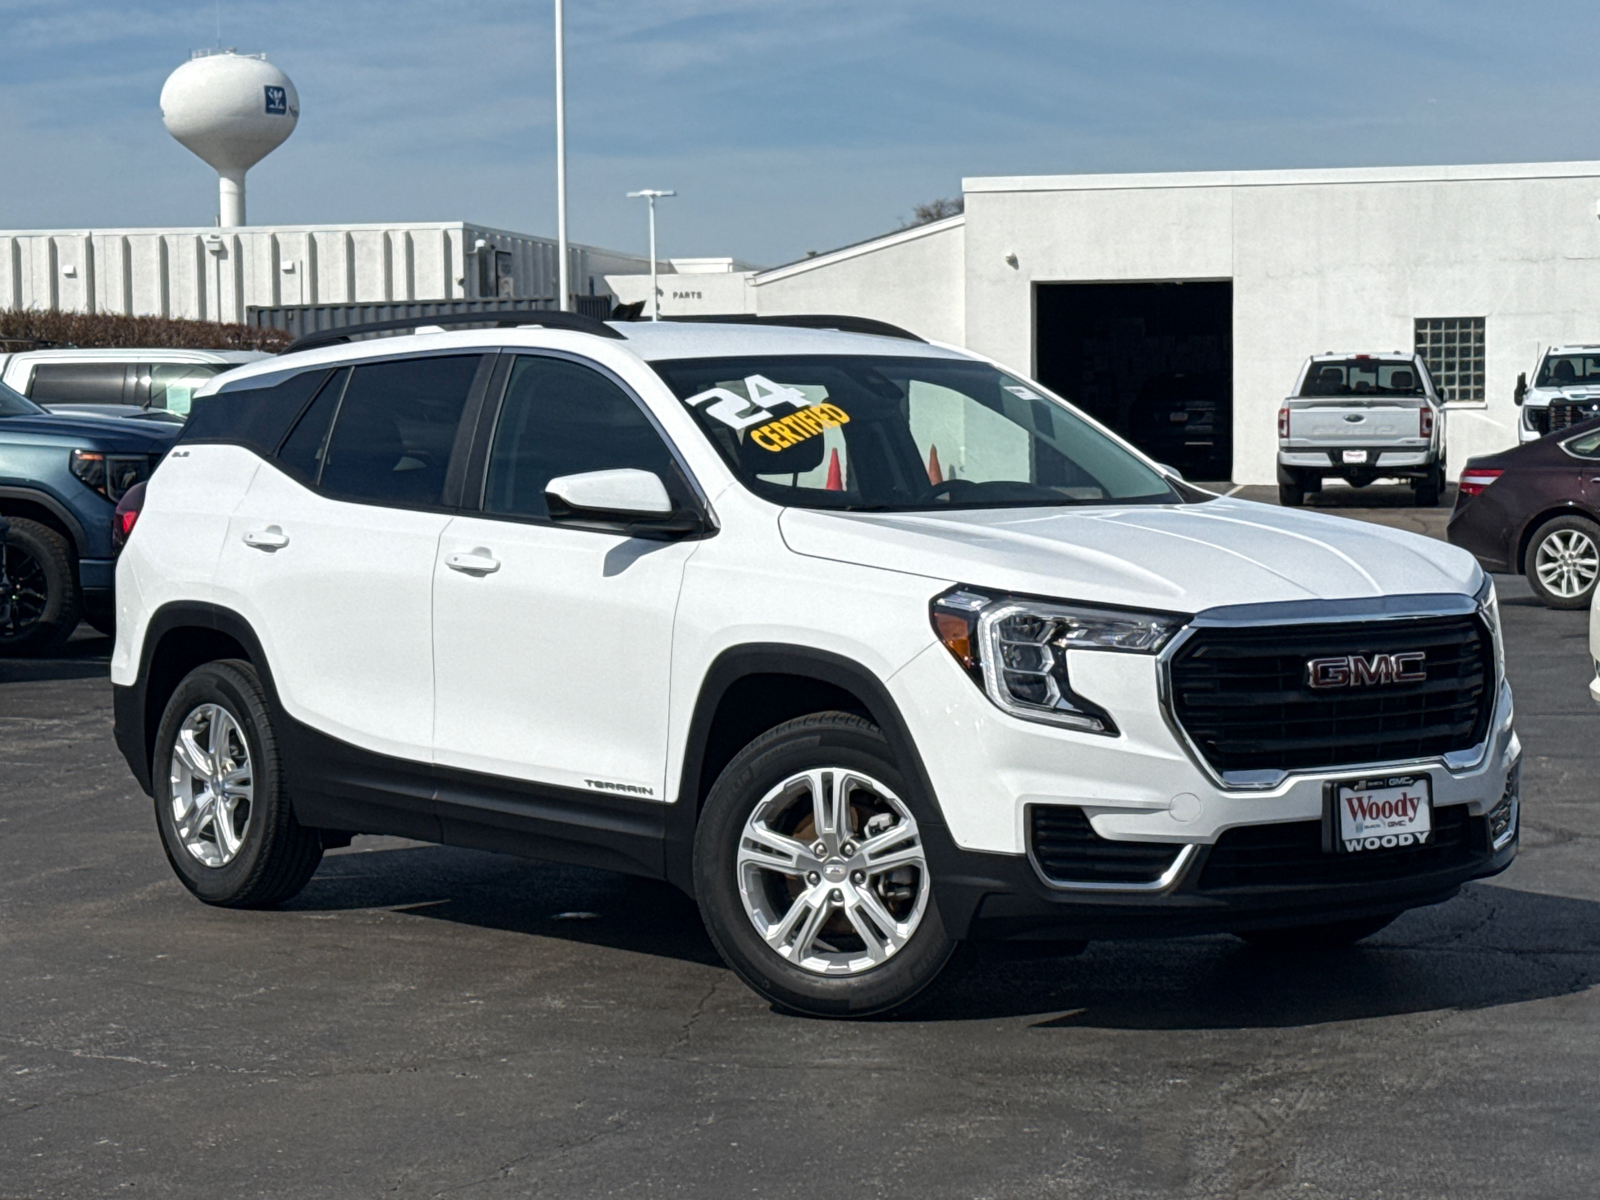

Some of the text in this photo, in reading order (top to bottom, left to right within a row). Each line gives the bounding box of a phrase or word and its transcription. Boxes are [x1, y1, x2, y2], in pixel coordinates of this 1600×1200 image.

[672, 291, 702, 299] PARTS
[684, 374, 812, 430] 24
[750, 403, 850, 452] CERTIFIED
[1307, 652, 1426, 688] GMC
[583, 779, 654, 796] TERRAIN
[1388, 776, 1412, 786] GMC
[1345, 792, 1421, 823] Woody
[1387, 820, 1406, 828] GMC
[1345, 831, 1430, 853] WOODY
